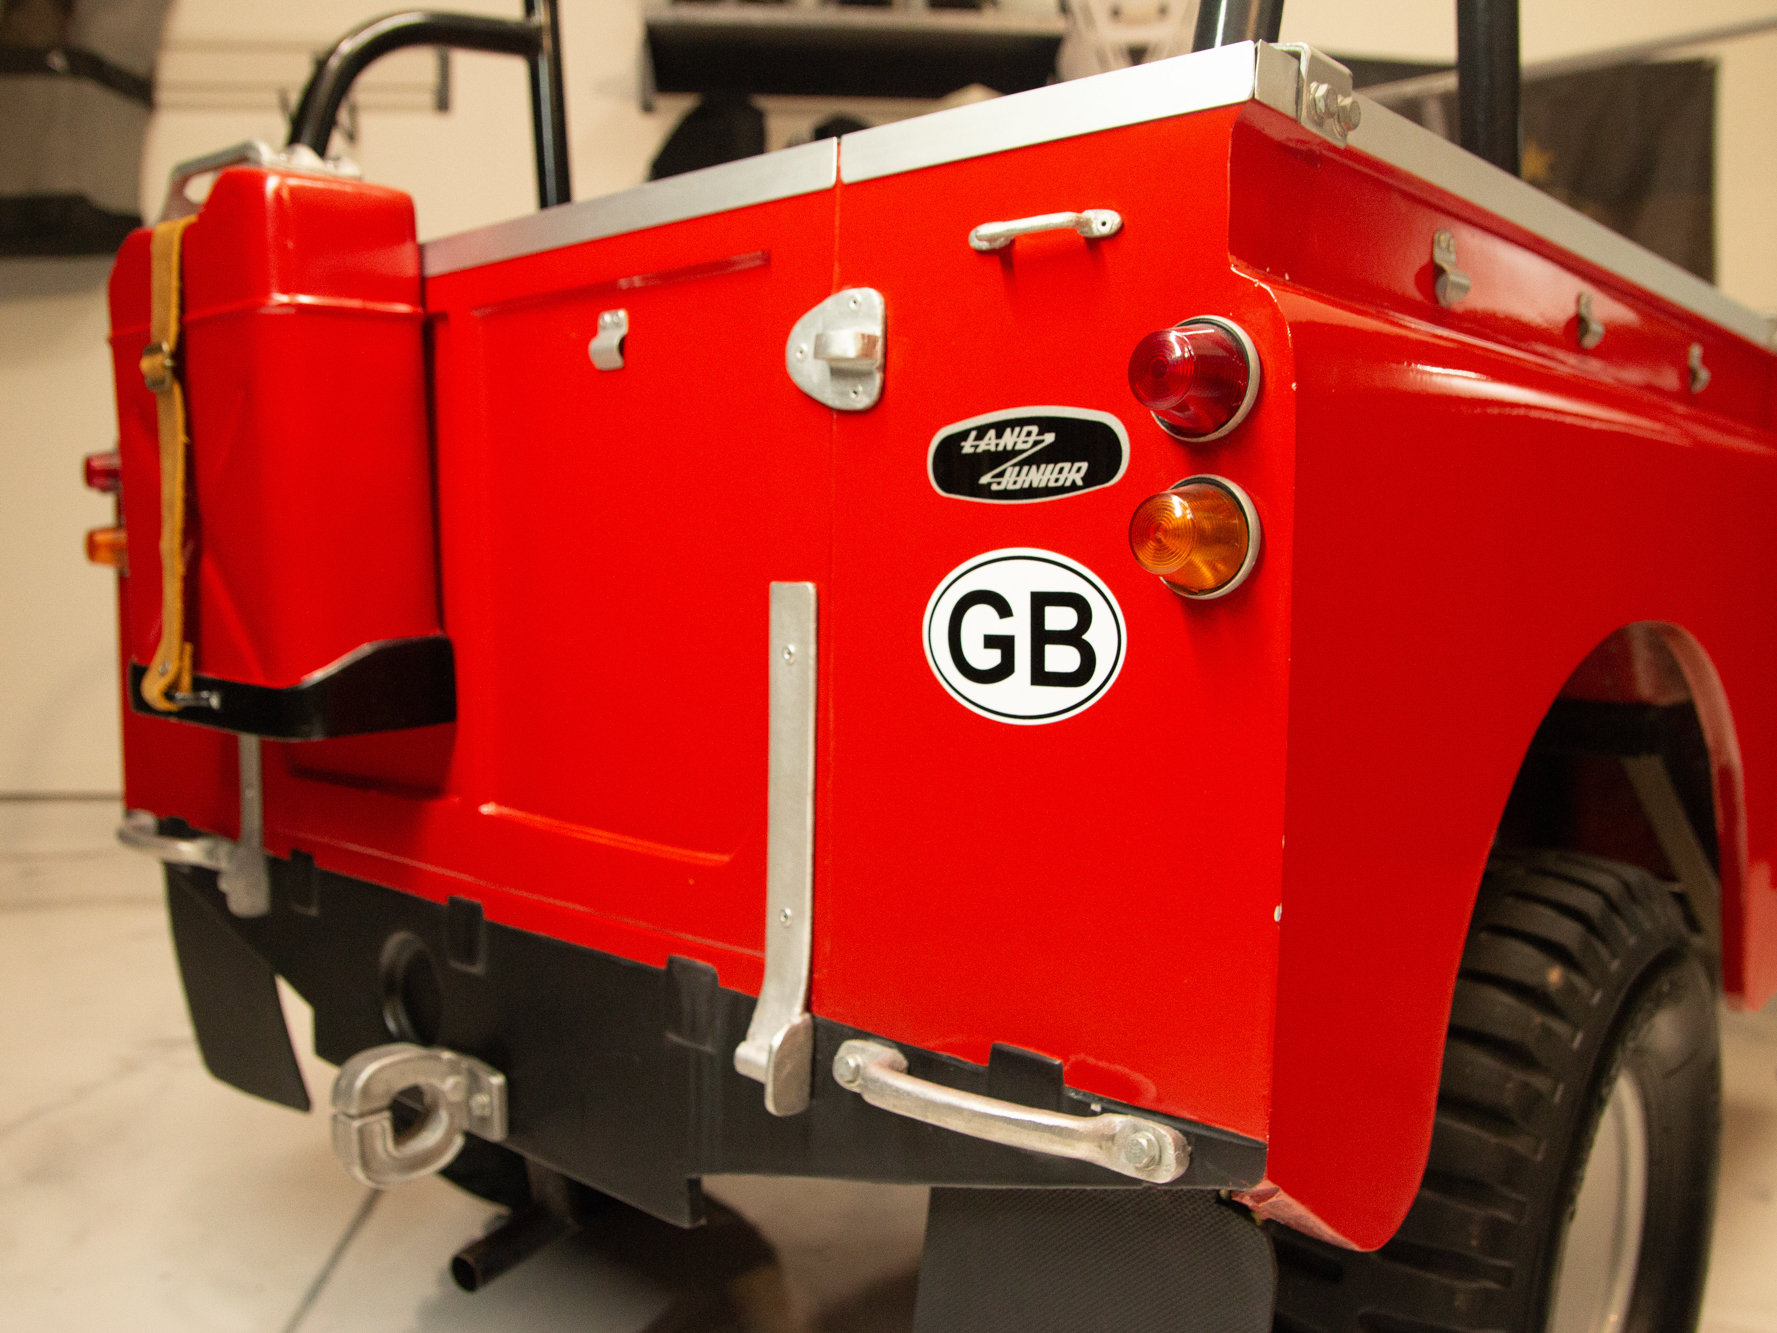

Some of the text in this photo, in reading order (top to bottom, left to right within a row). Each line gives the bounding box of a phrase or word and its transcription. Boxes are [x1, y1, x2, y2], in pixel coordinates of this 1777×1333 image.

[961, 425, 1039, 454] LAND
[990, 461, 1088, 490] JUNIOR
[947, 589, 1097, 688] GB
